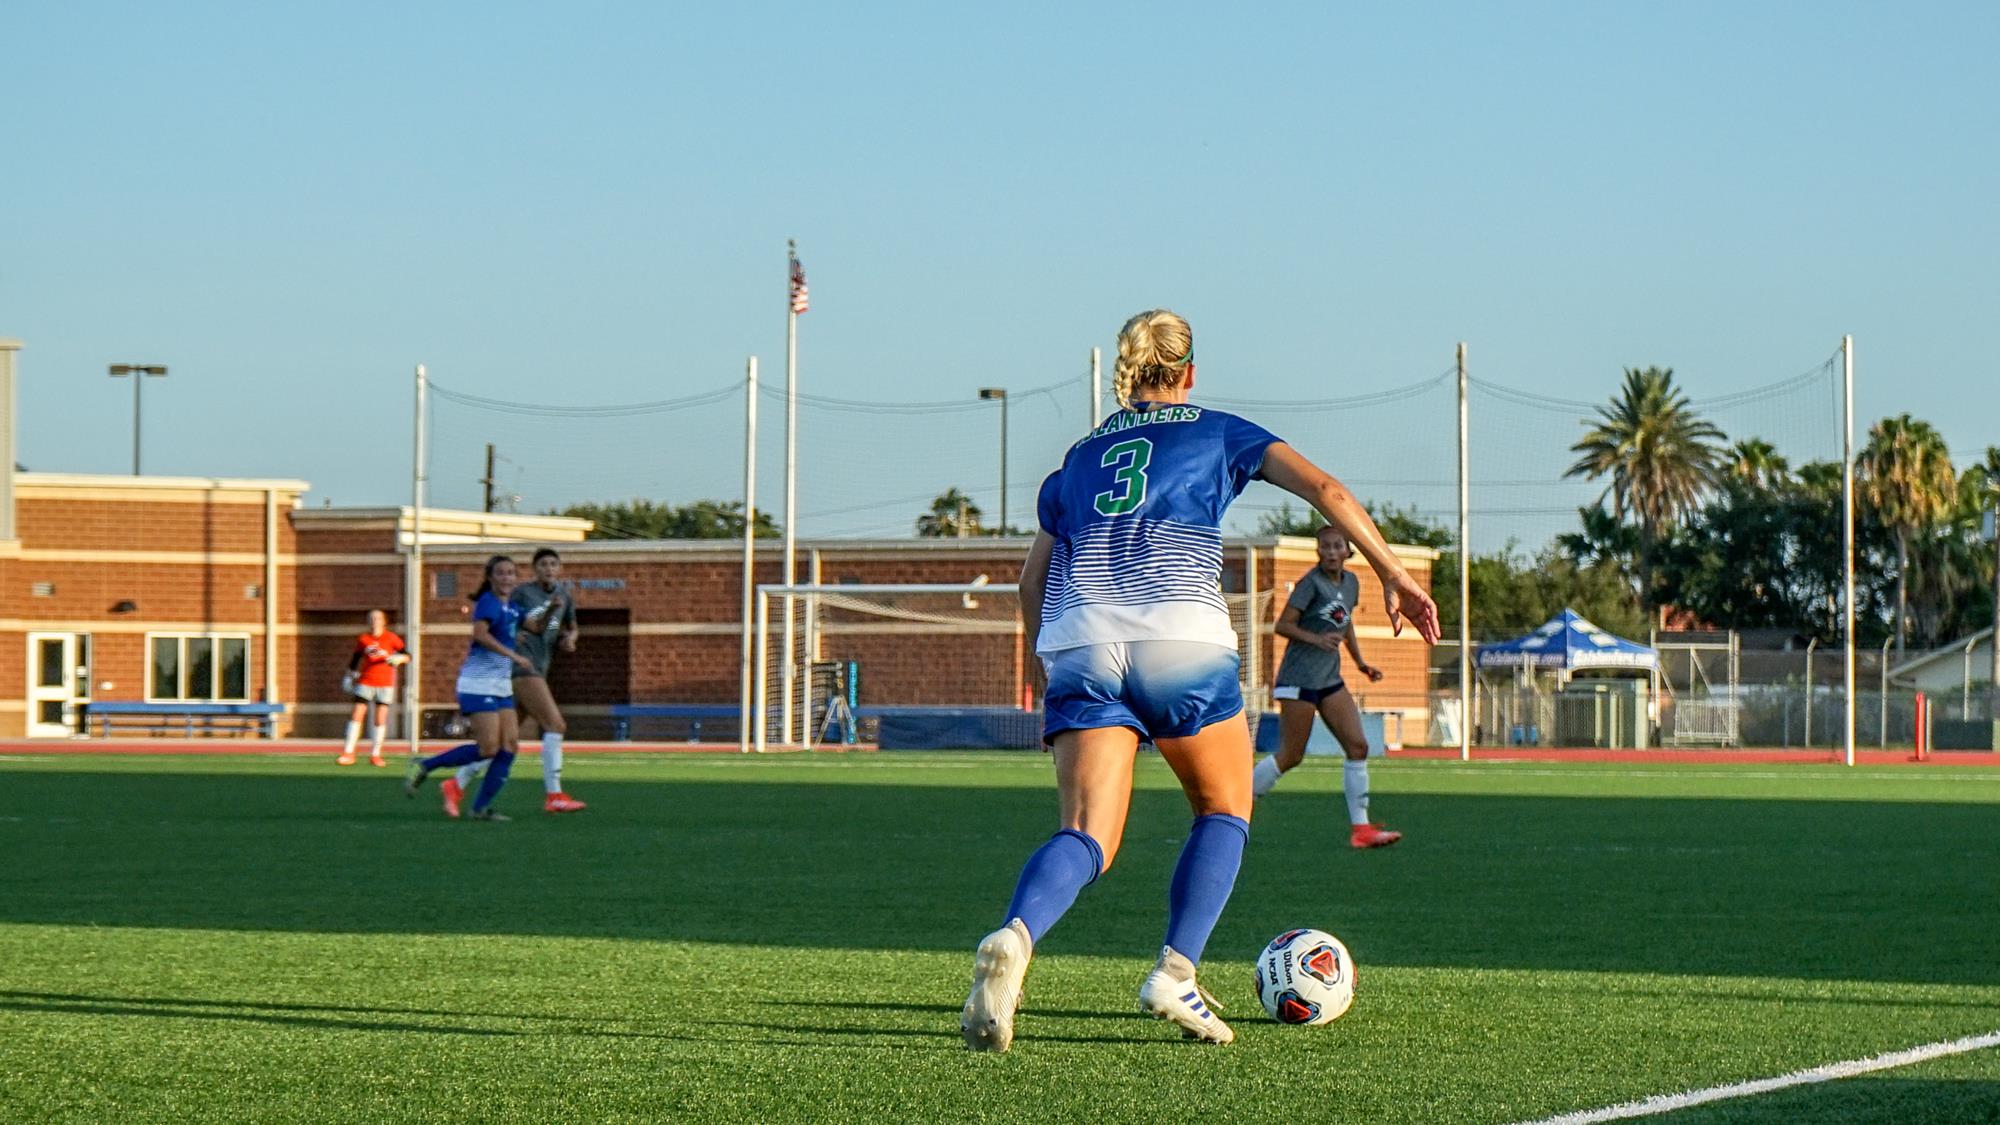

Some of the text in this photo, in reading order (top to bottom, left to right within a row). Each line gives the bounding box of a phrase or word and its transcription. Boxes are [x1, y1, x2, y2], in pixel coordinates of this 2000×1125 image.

[1076, 407, 1201, 448] LANDERS
[1094, 437, 1153, 517] 3
[1269, 957, 1279, 985] NCAA
[1283, 950, 1293, 985] Wilson
